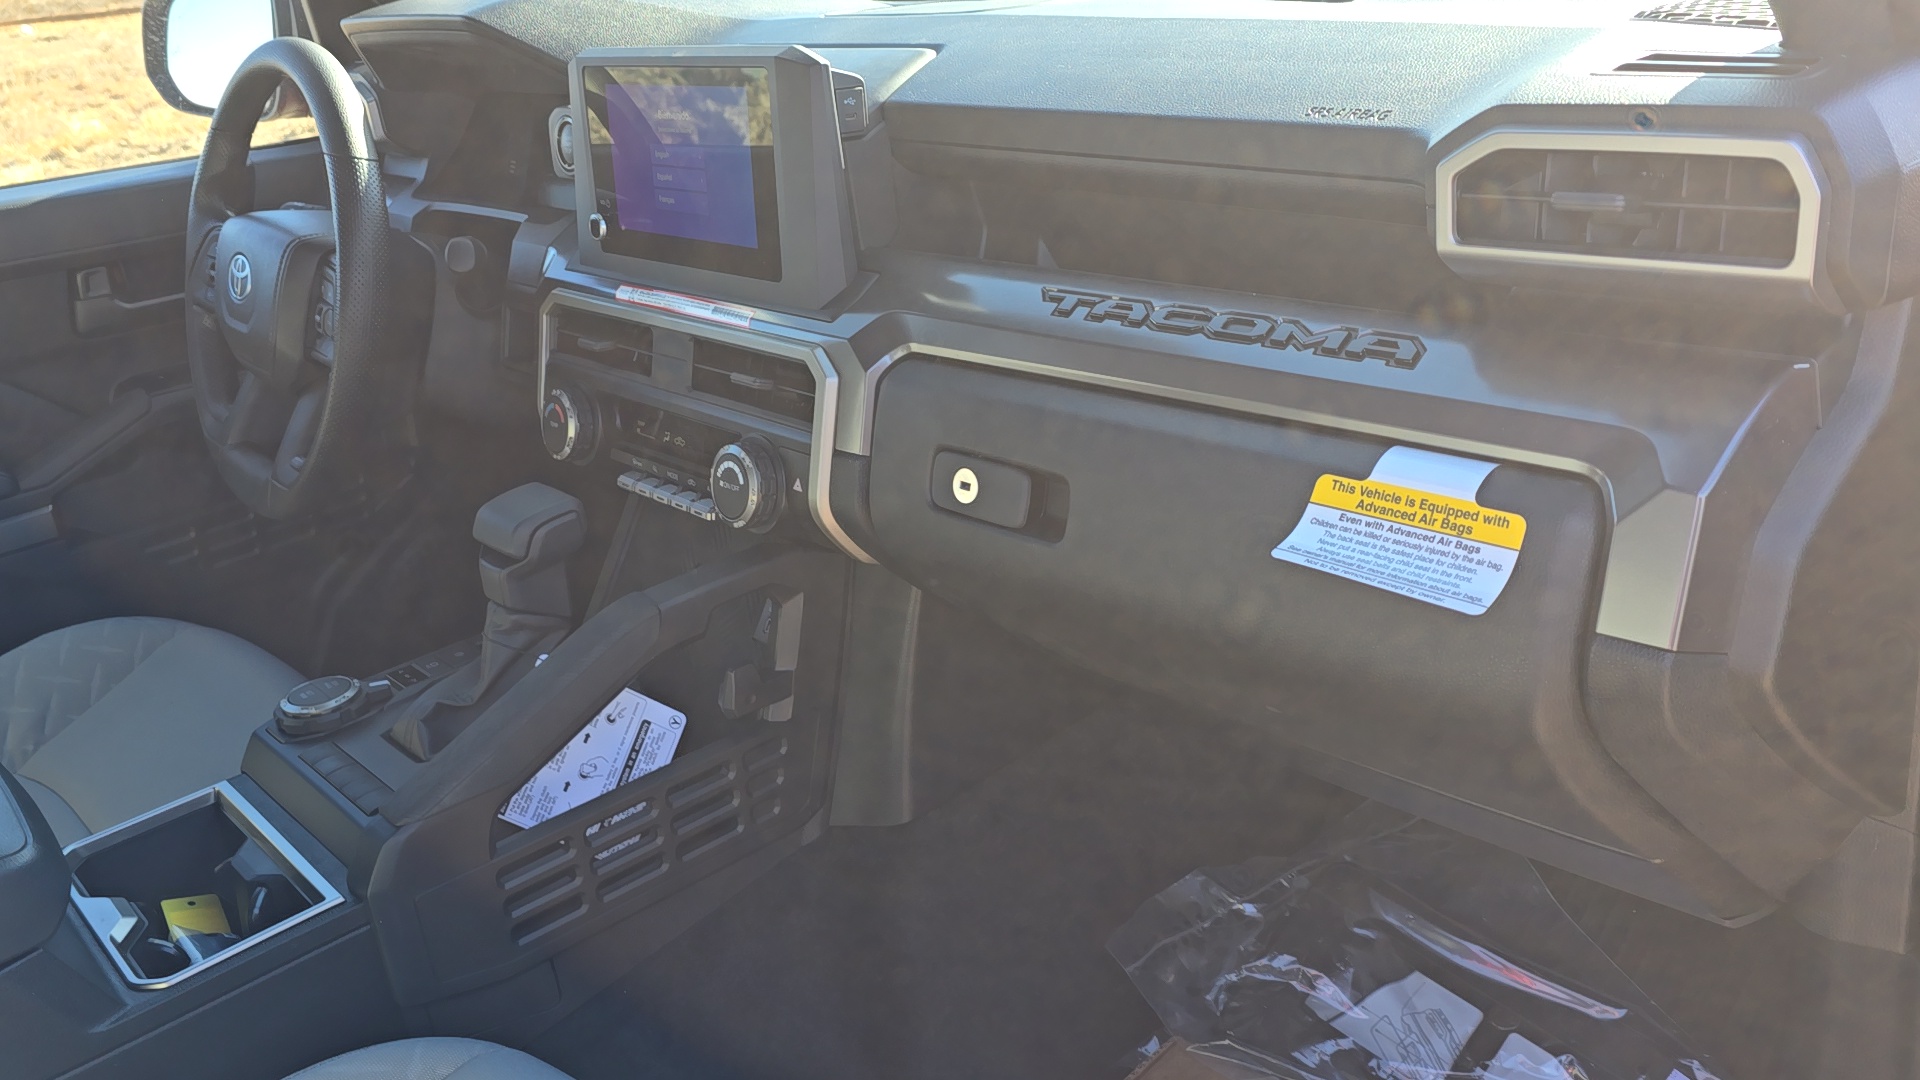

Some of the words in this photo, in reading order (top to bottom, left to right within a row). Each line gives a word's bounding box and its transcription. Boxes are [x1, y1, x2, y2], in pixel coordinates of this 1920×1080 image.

[1305, 106, 1334, 118] SRS
[1332, 107, 1393, 120] AIRBAG
[1041, 285, 1428, 370] TACOMA
[1332, 479, 1357, 495] This
[1360, 485, 1402, 505] Vehicle
[1404, 495, 1416, 508] is
[1419, 498, 1480, 522] Equipped
[1483, 514, 1510, 529] with
[1355, 499, 1417, 522] Advanced
[1418, 513, 1438, 527] Air
[1440, 518, 1474, 536] Bags
[1309, 517, 1339, 530] Children
[1339, 525, 1353, 534] can
[1352, 526, 1363, 536] be
[1363, 529, 1381, 541] killed
[1381, 535, 1391, 543] or
[1391, 537, 1424, 552] seriously
[1424, 544, 1450, 558] injured
[1450, 550, 1461, 561] by
[1462, 553, 1475, 564] the
[1475, 558, 1486, 567] air
[1486, 560, 1504, 573] bag.
[1322, 529, 1337, 539] The
[1337, 533, 1355, 544] back
[1354, 538, 1371, 548] seat
[1371, 541, 1379, 550] is
[1379, 544, 1392, 553] the
[1391, 548, 1414, 558] safest
[1413, 553, 1435, 564] place
[1435, 558, 1447, 567] for
[1446, 561, 1478, 576] children.
[1338, 513, 1363, 526] Even
[1364, 519, 1385, 531] with
[1386, 524, 1436, 543] Advanced
[1436, 536, 1453, 547] Air
[1454, 541, 1481, 555] Bags
[1317, 538, 1338, 548] Never
[1336, 543, 1351, 551] put
[1395, 557, 1413, 568] child
[1413, 562, 1432, 571] seat
[1431, 566, 1440, 575] in
[1439, 568, 1453, 579] the
[1453, 573, 1473, 584] front.
[1390, 566, 1406, 575] and
[1406, 569, 1425, 579] child
[629, 750, 637, 759] an
[632, 721, 651, 751] emergency
[626, 758, 634, 766] in
